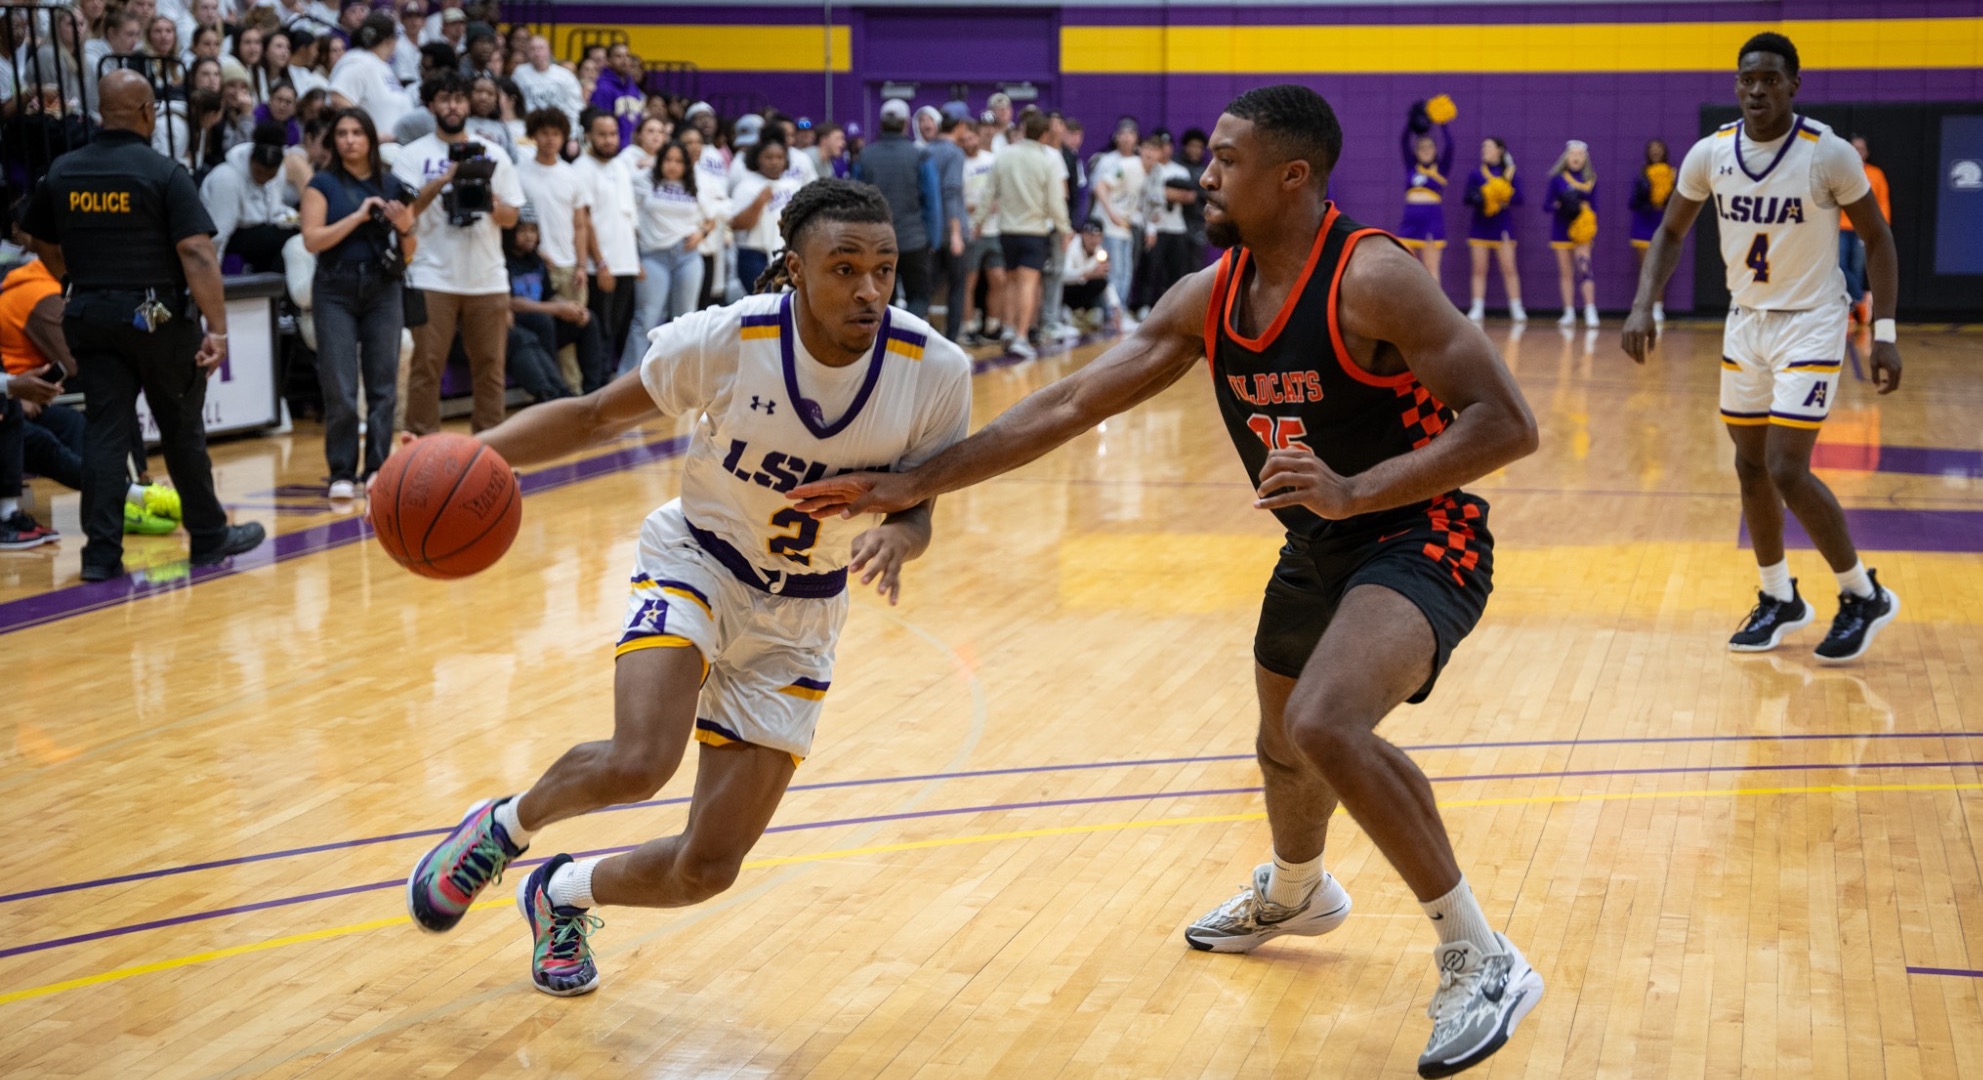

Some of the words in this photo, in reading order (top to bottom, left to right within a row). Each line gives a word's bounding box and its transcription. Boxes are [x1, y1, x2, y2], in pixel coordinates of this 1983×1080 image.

[69, 191, 130, 213] POLICE
[1716, 193, 1805, 224] LSUA
[1745, 233, 1770, 283] 4
[722, 438, 890, 494] LS
[767, 505, 823, 567] 2
